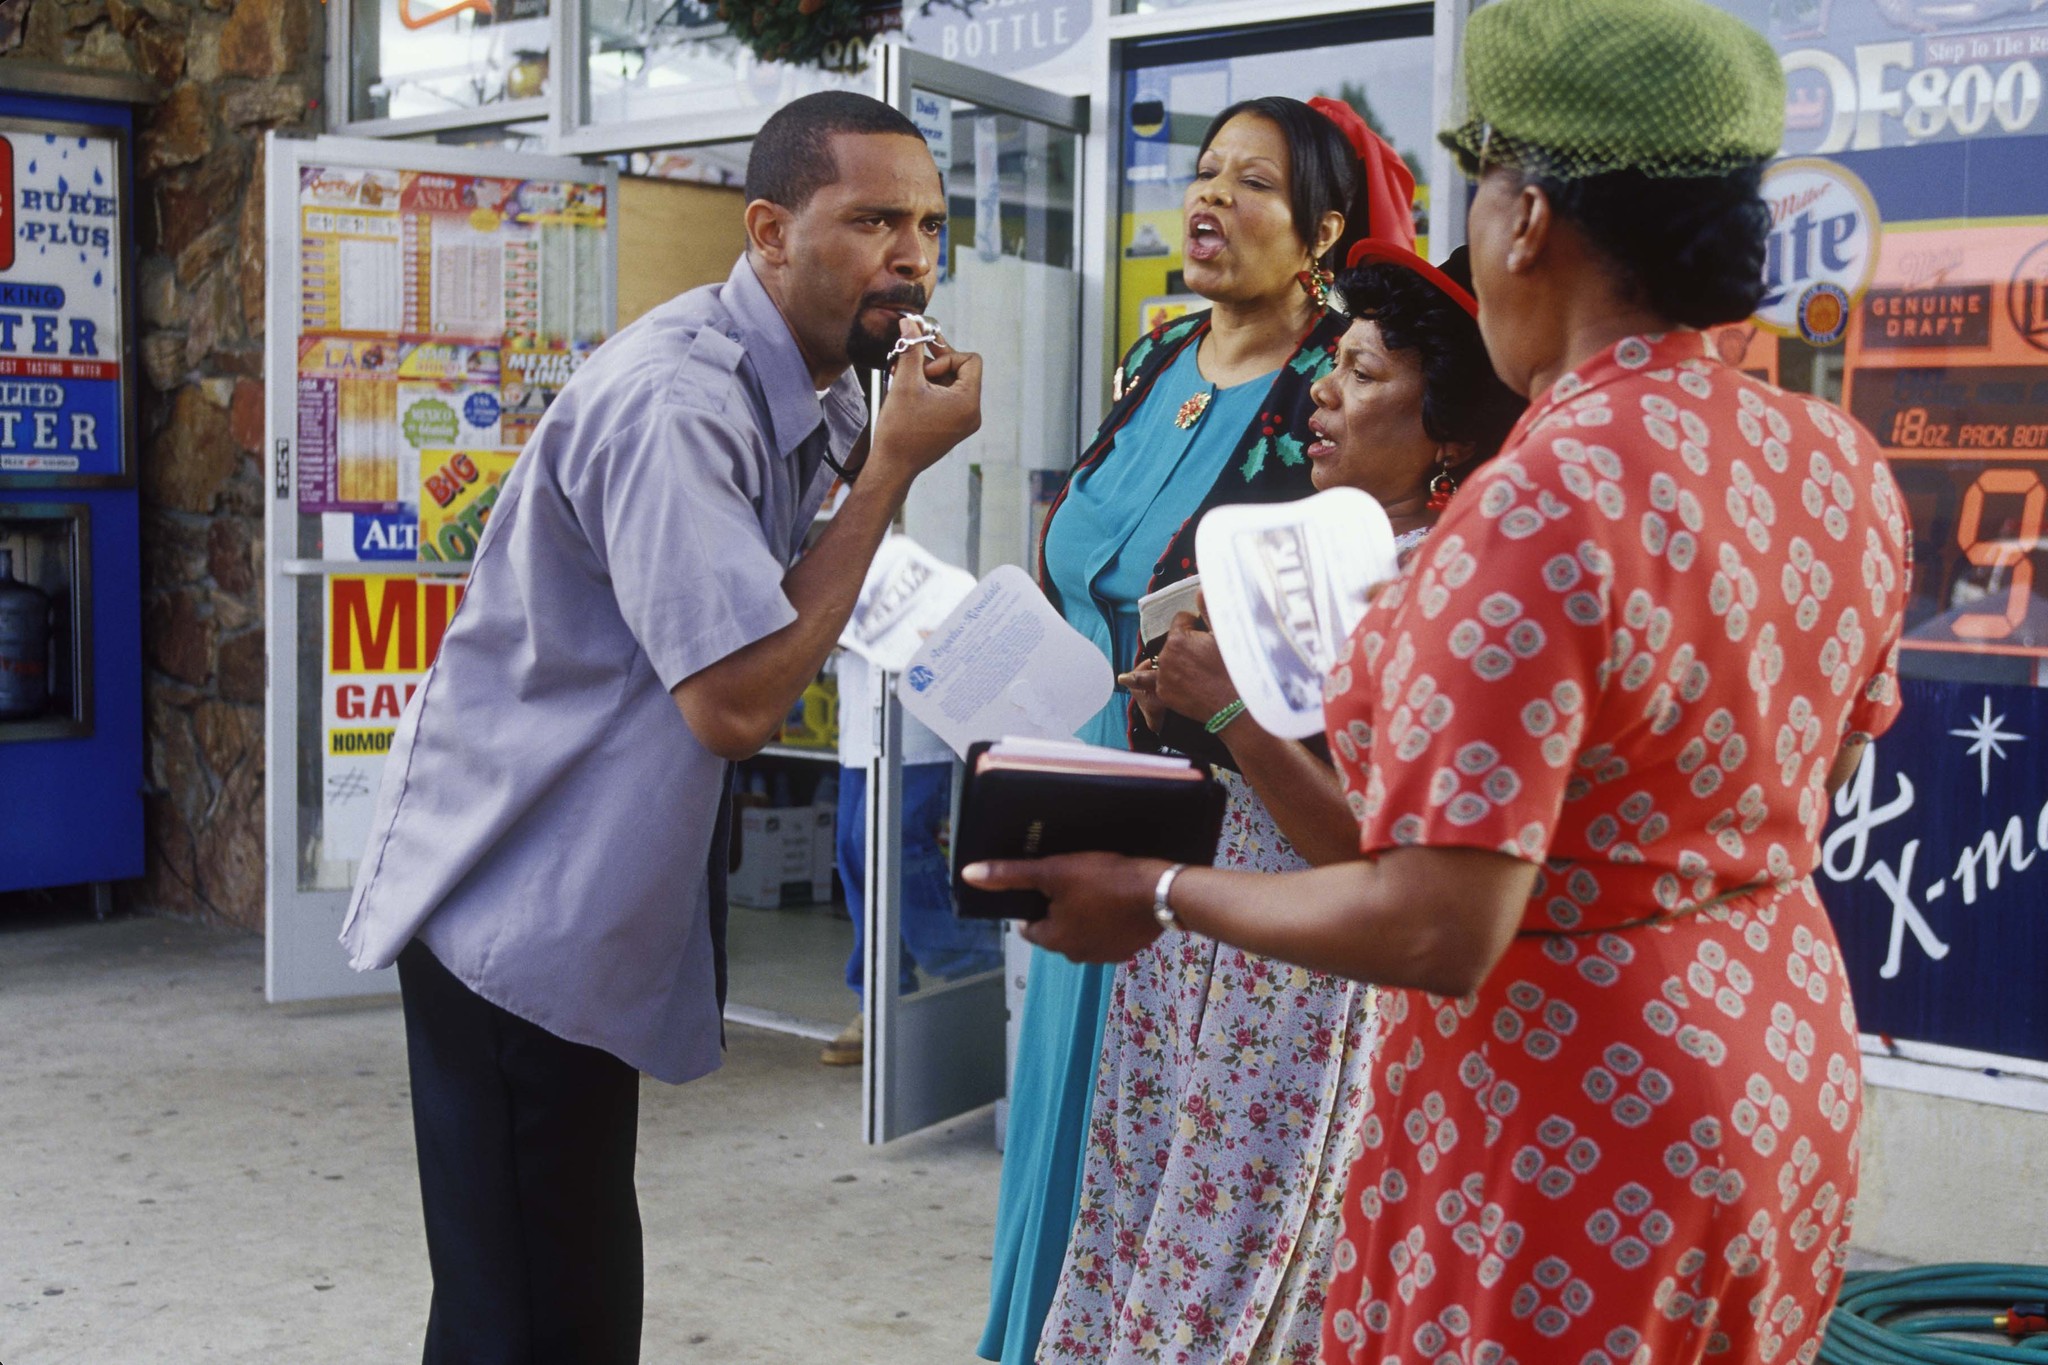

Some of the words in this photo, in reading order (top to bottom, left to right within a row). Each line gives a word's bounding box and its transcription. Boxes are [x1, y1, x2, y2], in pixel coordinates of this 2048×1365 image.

[941, 6, 1070, 61] BOTTLE
[916, 97, 939, 120] Daily
[413, 189, 460, 211] ASIA
[25, 222, 110, 249] PLUS
[1764, 211, 1858, 291] ite
[1871, 294, 1982, 317] GENUINE
[1886, 316, 1966, 337] DRAFT
[1958, 424, 2009, 447] PACK
[424, 451, 479, 508] BIG
